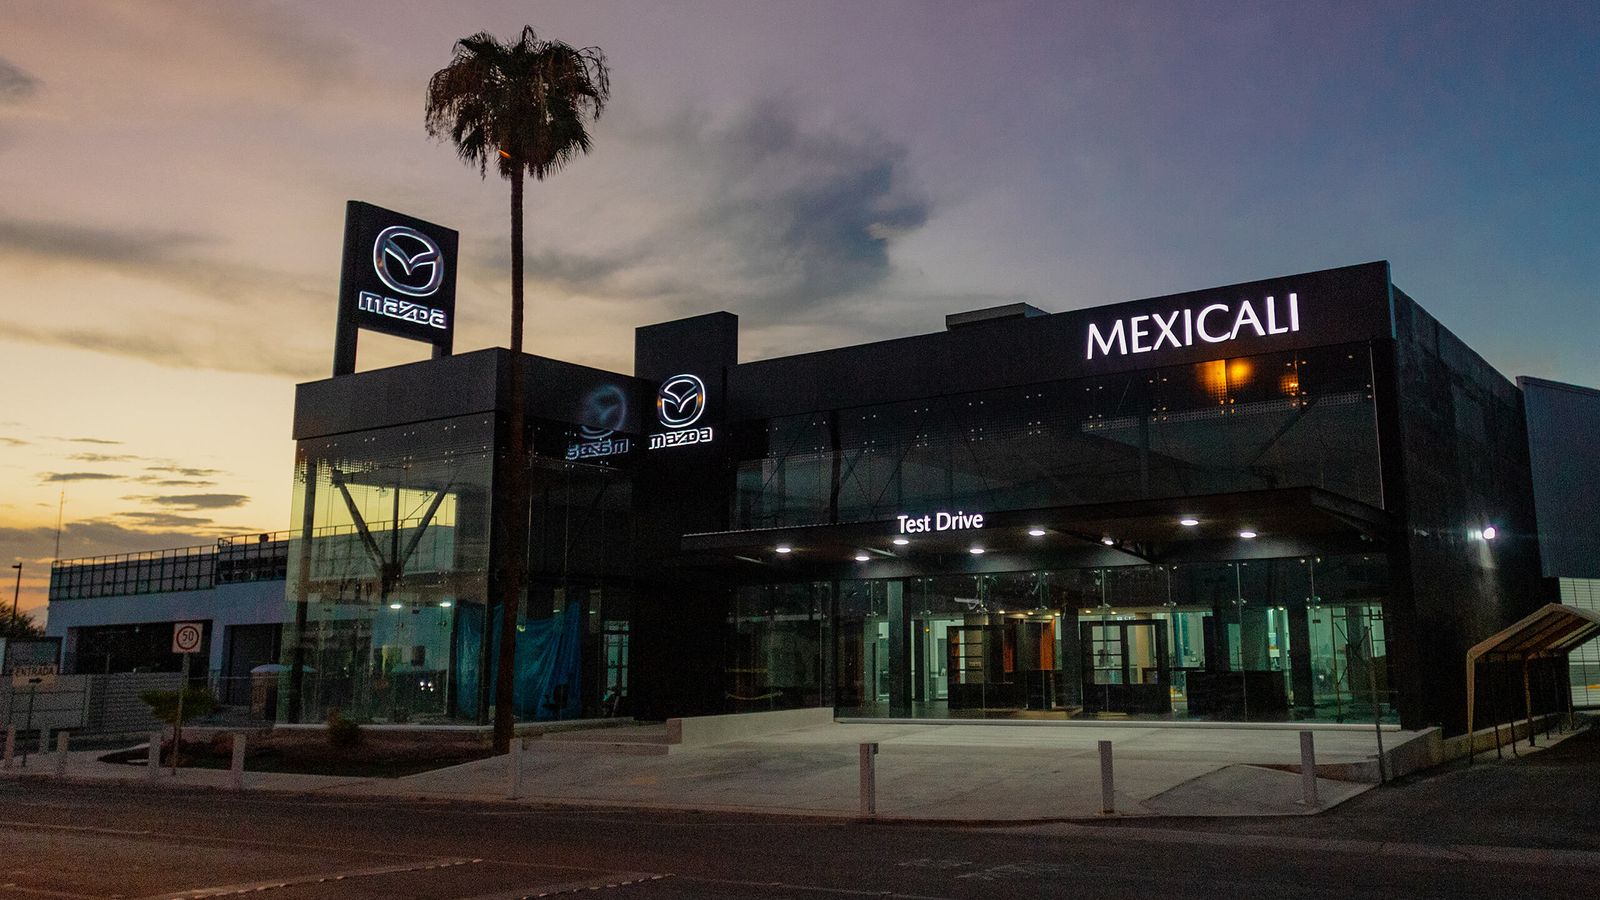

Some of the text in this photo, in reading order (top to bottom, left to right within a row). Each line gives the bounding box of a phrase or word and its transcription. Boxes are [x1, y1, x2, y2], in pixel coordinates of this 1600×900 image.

[358, 290, 447, 329] mazda
[1087, 293, 1300, 360] MEXICALI
[648, 427, 712, 450] mazda
[897, 510, 984, 534] Test Drive
[182, 630, 194, 642] 50
